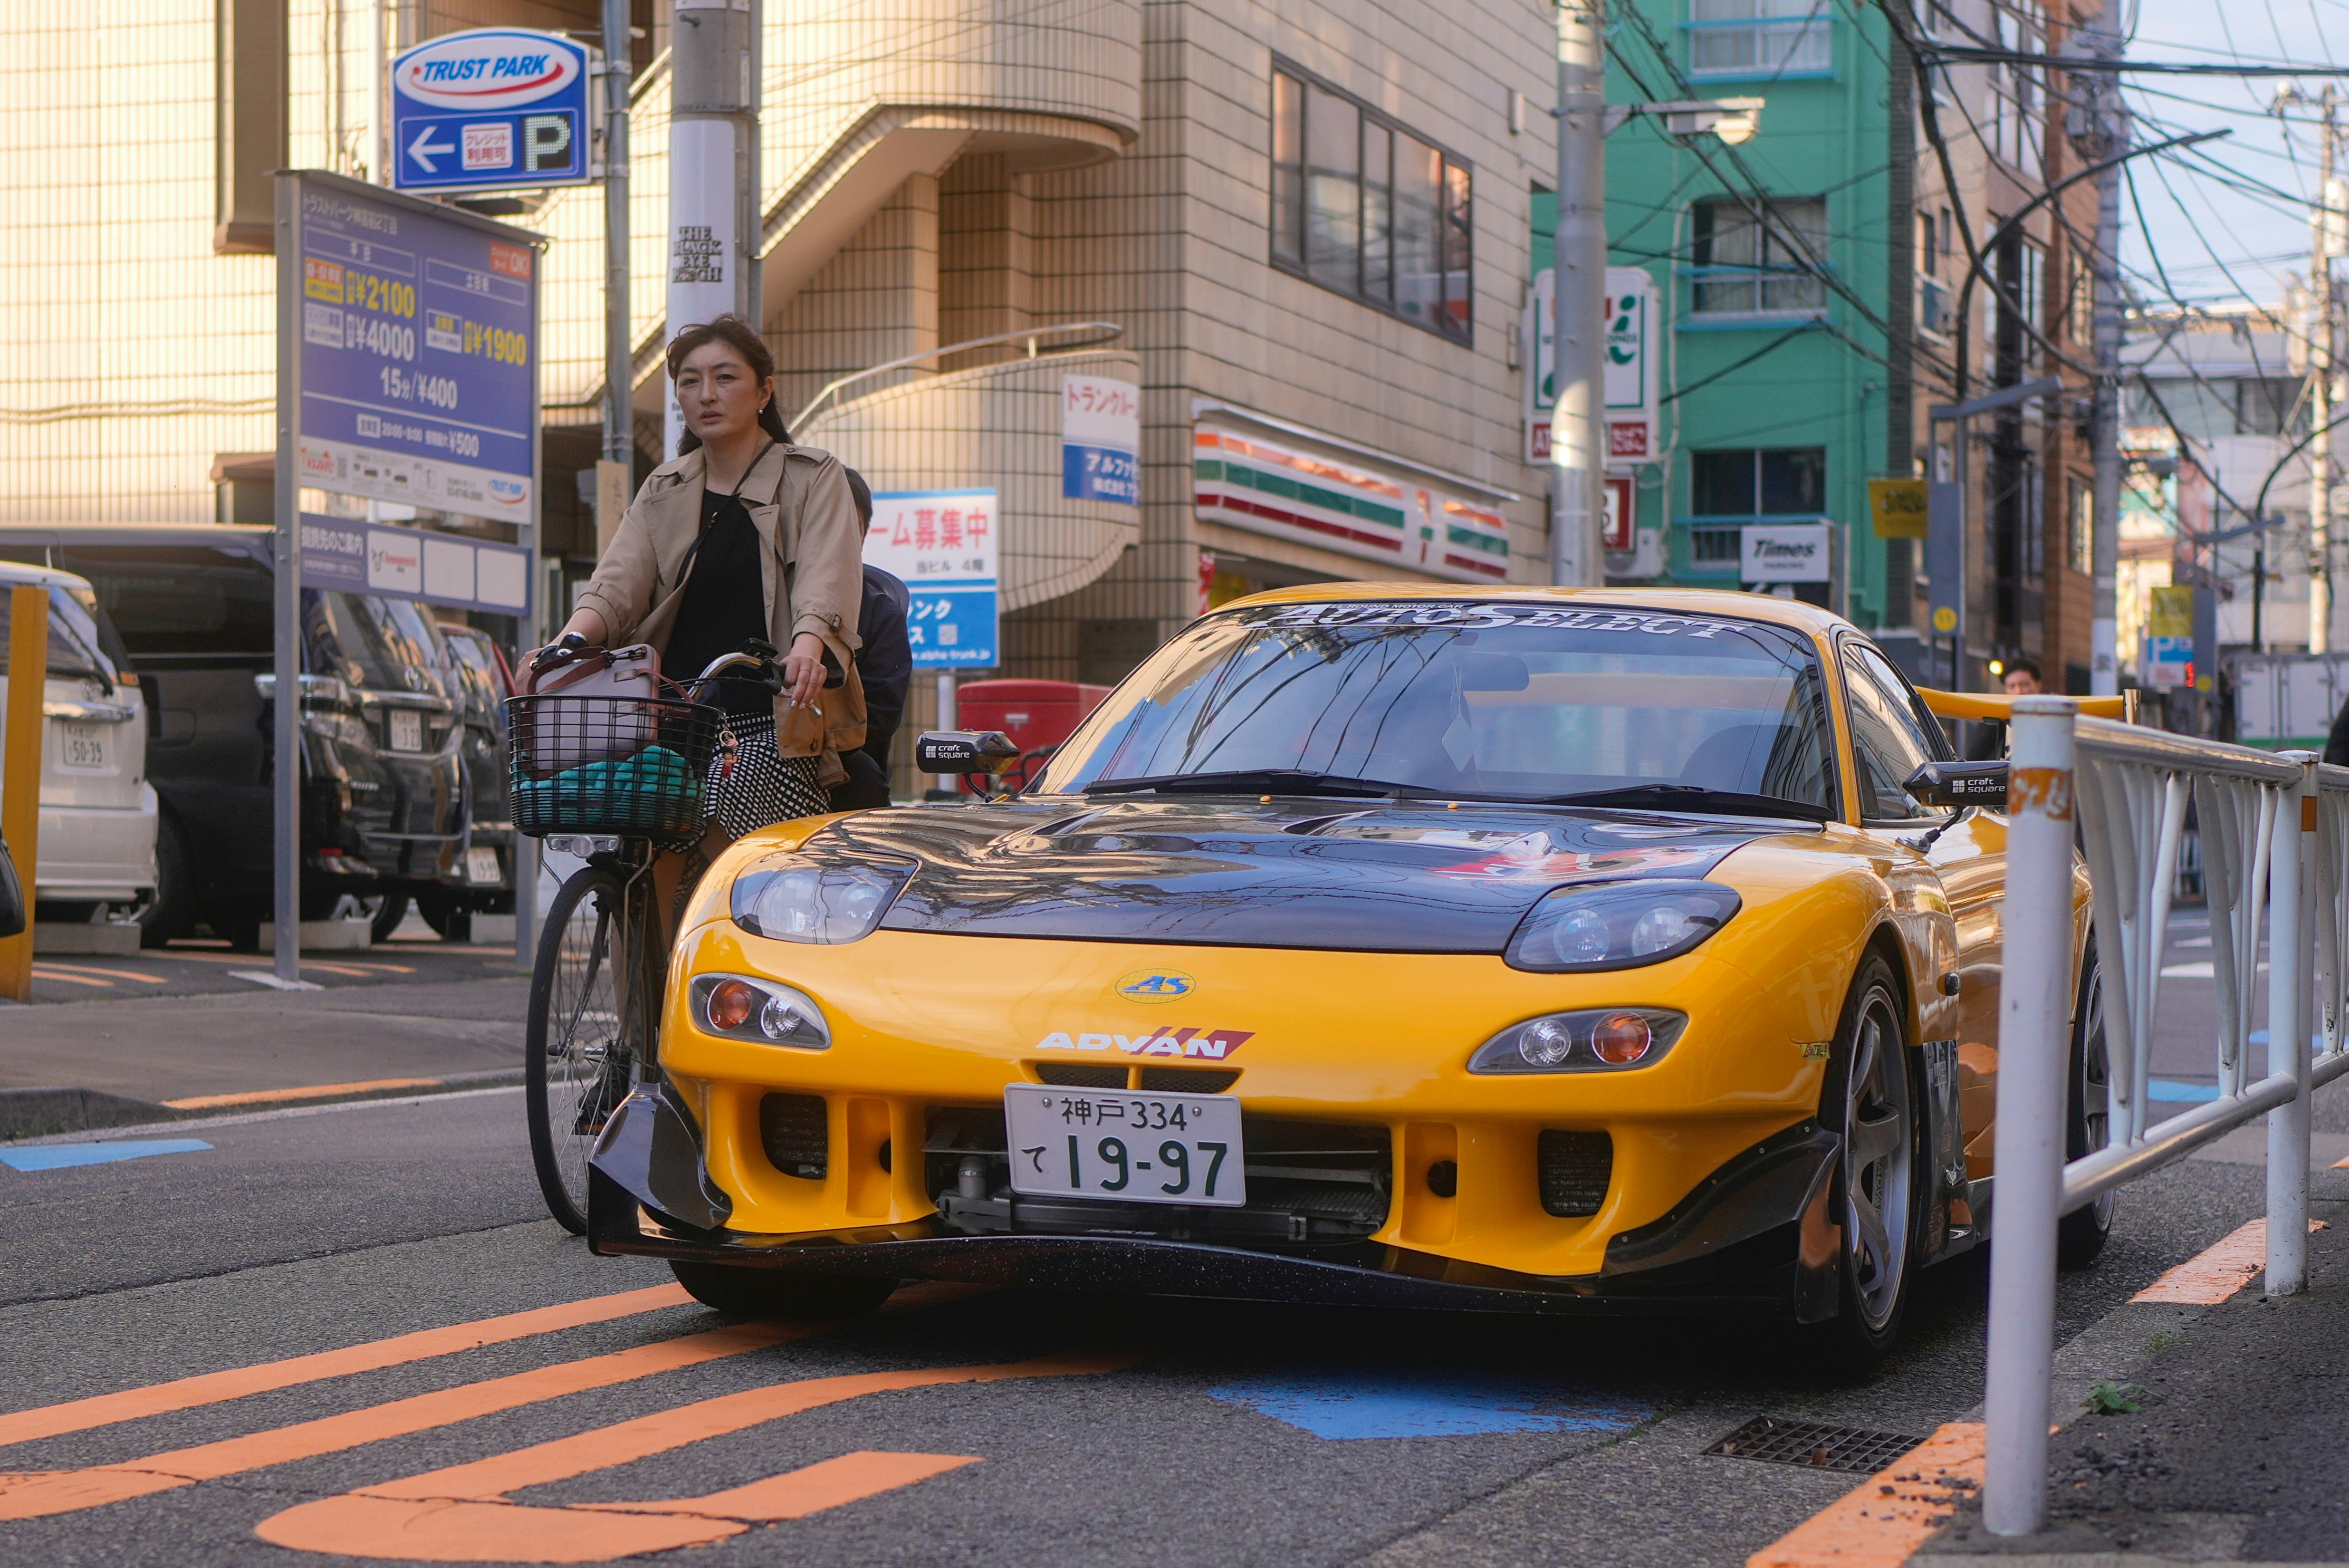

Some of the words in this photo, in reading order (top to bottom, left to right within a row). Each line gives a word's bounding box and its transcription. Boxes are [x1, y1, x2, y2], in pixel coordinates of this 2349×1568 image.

[423, 59, 490, 82] TRUST
[492, 54, 550, 78] PARK
[466, 133, 508, 146] クレジット
[525, 115, 571, 171] P
[467, 147, 506, 161] 利用可
[679, 227, 712, 241] THE
[673, 241, 723, 256] BLACK
[683, 254, 711, 268] EYE
[1967, 785, 2005, 794] square
[1121, 975, 1191, 995] AS
[1036, 1032, 1227, 1058] ADVAN
[1021, 1145, 1047, 1173] て
[1068, 1134, 1228, 1197] 19-97
